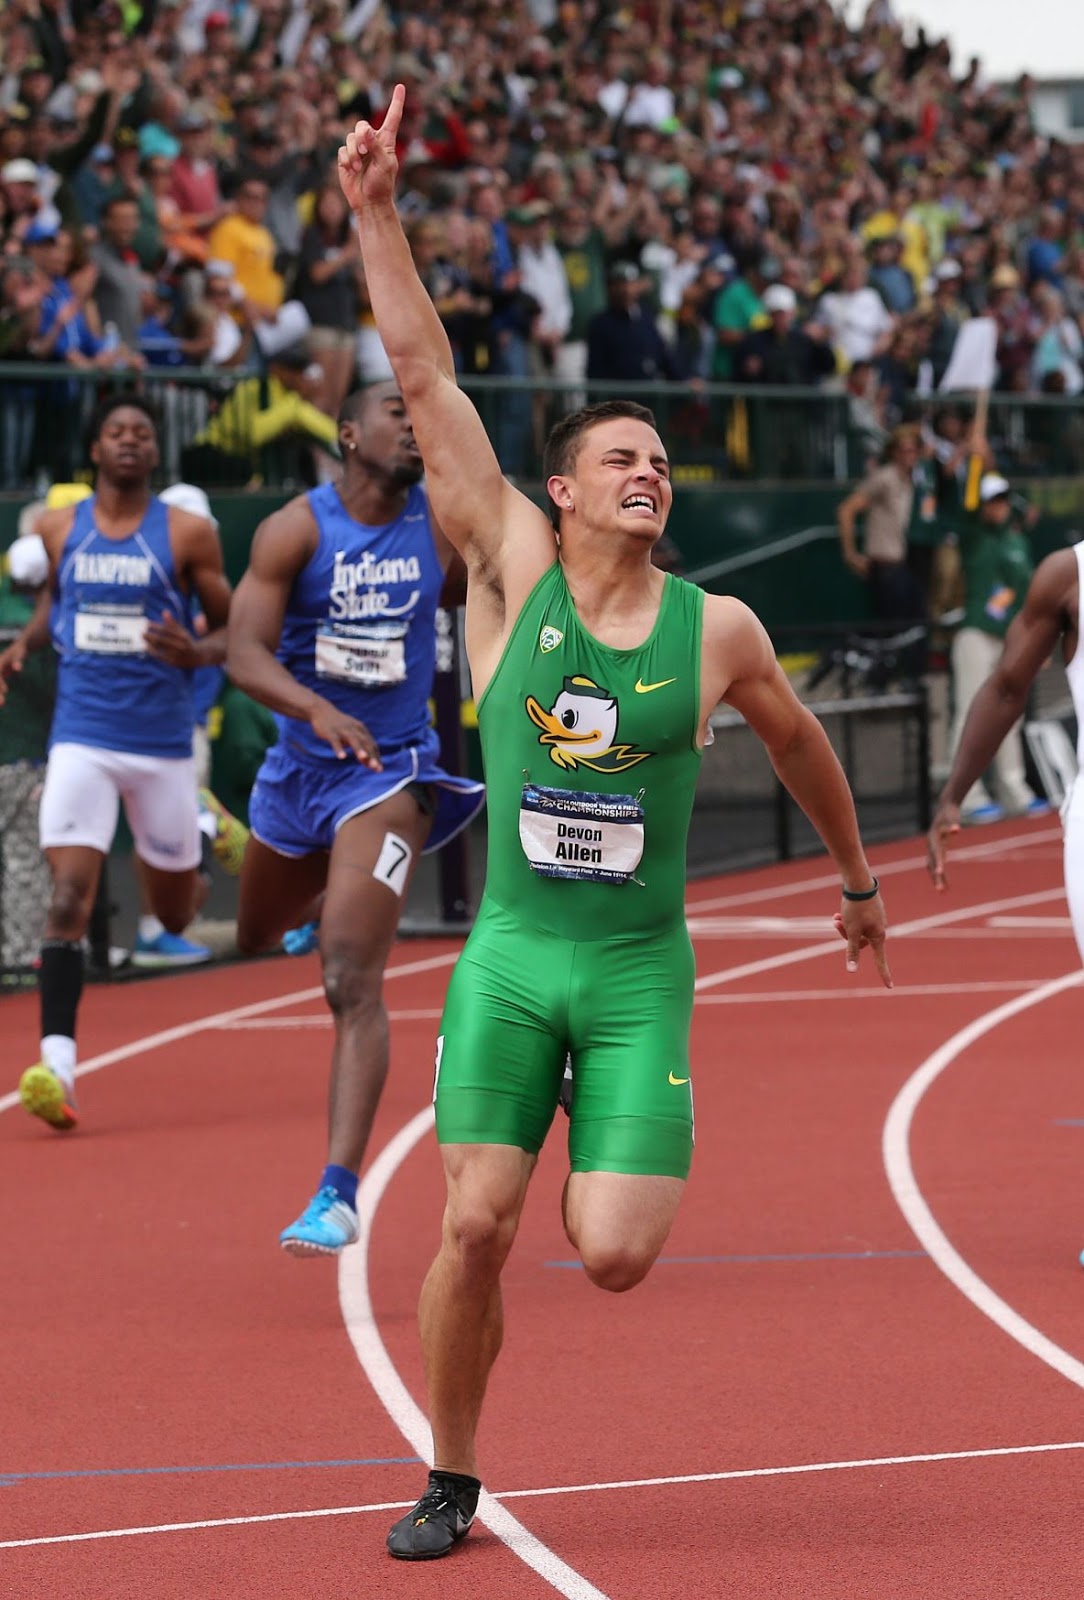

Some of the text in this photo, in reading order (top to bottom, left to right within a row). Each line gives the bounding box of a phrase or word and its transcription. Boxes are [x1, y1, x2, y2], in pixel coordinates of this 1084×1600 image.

[74, 552, 151, 586] HAMPTON
[333, 551, 421, 586] Indiana
[329, 583, 420, 620] State
[556, 802, 638, 818] CHAMPIONSHIPS
[569, 800, 598, 809] OUTDOOR
[557, 823, 602, 841] Devon
[391, 841, 407, 878] 7
[555, 842, 602, 862] Allen
